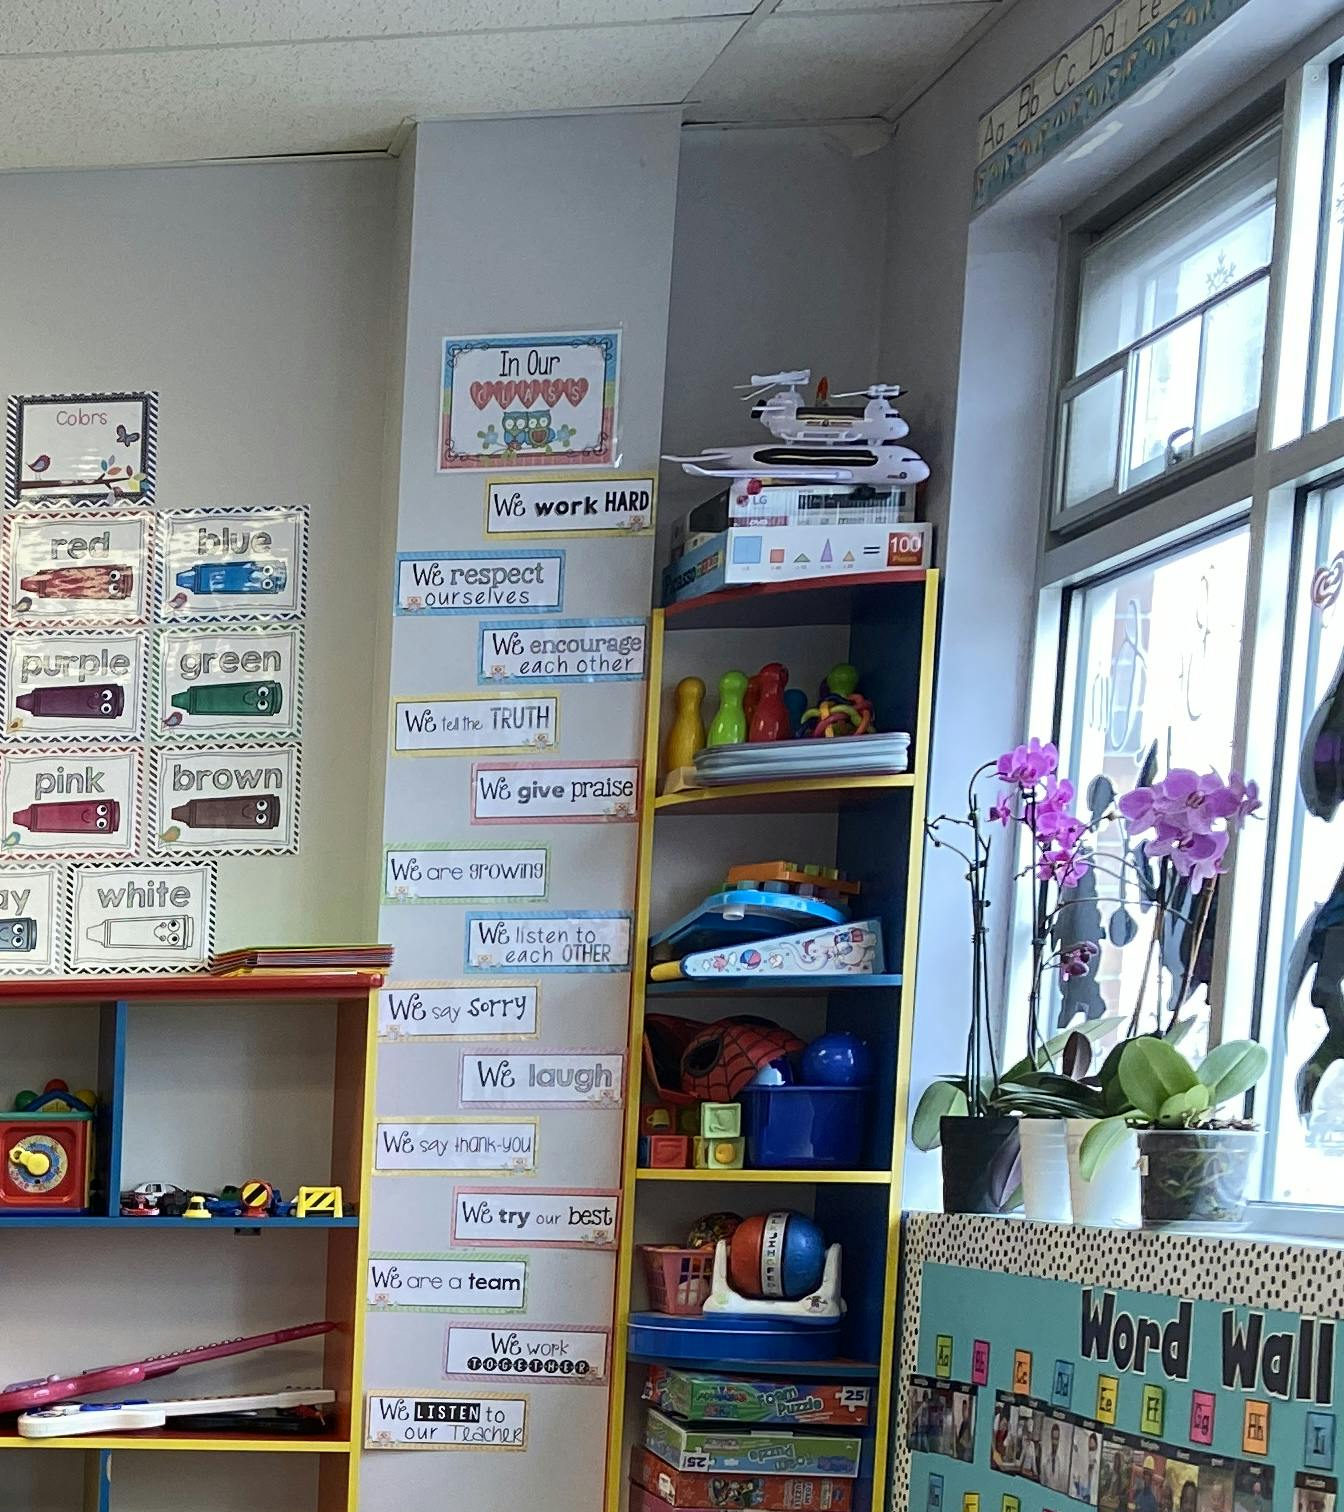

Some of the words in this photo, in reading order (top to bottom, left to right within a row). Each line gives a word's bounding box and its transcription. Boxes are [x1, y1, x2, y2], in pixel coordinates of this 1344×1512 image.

[499, 350, 519, 376] In
[527, 350, 560, 376] Our
[477, 386, 581, 404] CLASS
[56, 409, 108, 427] Colors
[494, 493, 525, 516] We
[535, 497, 598, 517] work
[605, 491, 649, 512] HARD
[753, 495, 767, 505] LG
[51, 532, 110, 559] red
[198, 528, 272, 555] blue
[890, 536, 921, 552] 100
[413, 563, 445, 587] We
[450, 564, 544, 588] respect
[425, 588, 530, 606] ourselves
[492, 632, 524, 655] We
[531, 634, 642, 659] encourage
[21, 648, 131, 681] purple
[181, 649, 281, 678] green
[519, 657, 568, 674] each
[576, 655, 635, 673] other
[405, 709, 436, 732] We
[442, 716, 459, 730] tell
[462, 716, 483, 730] the
[490, 706, 550, 730] TRUTH
[35, 766, 105, 799] pink
[173, 765, 282, 791] brown
[479, 777, 512, 801] We
[518, 782, 565, 805] give
[571, 777, 634, 802] praise
[391, 858, 422, 881] We
[427, 863, 464, 880] are
[469, 859, 543, 881] growing
[98, 882, 191, 909] white
[478, 921, 511, 945] We
[515, 925, 570, 944] listen
[575, 926, 596, 943] to
[505, 946, 553, 962] each
[562, 945, 610, 963] OTHER
[389, 993, 426, 1021] We
[432, 1005, 460, 1023] say
[467, 995, 527, 1020] sorry
[477, 1061, 513, 1089] We
[528, 1061, 612, 1093] laugh
[383, 1132, 414, 1154] We
[419, 1138, 448, 1156] say
[454, 1136, 531, 1155] thank-you
[462, 1202, 493, 1225] We
[498, 1209, 530, 1230] try
[535, 1212, 562, 1226] our
[568, 1207, 612, 1226] best
[371, 1266, 403, 1289] We
[407, 1273, 443, 1289] are
[449, 1273, 463, 1289] a
[467, 1274, 520, 1291] team
[491, 1333, 522, 1355] We
[527, 1339, 569, 1356] work
[1081, 1287, 1194, 1382] Word
[1222, 1308, 1336, 1406] Wall
[467, 1356, 589, 1373] TOGETHER
[379, 1400, 410, 1421] We
[415, 1403, 480, 1422] LISTEN
[486, 1407, 505, 1423] to
[404, 1427, 437, 1442] our
